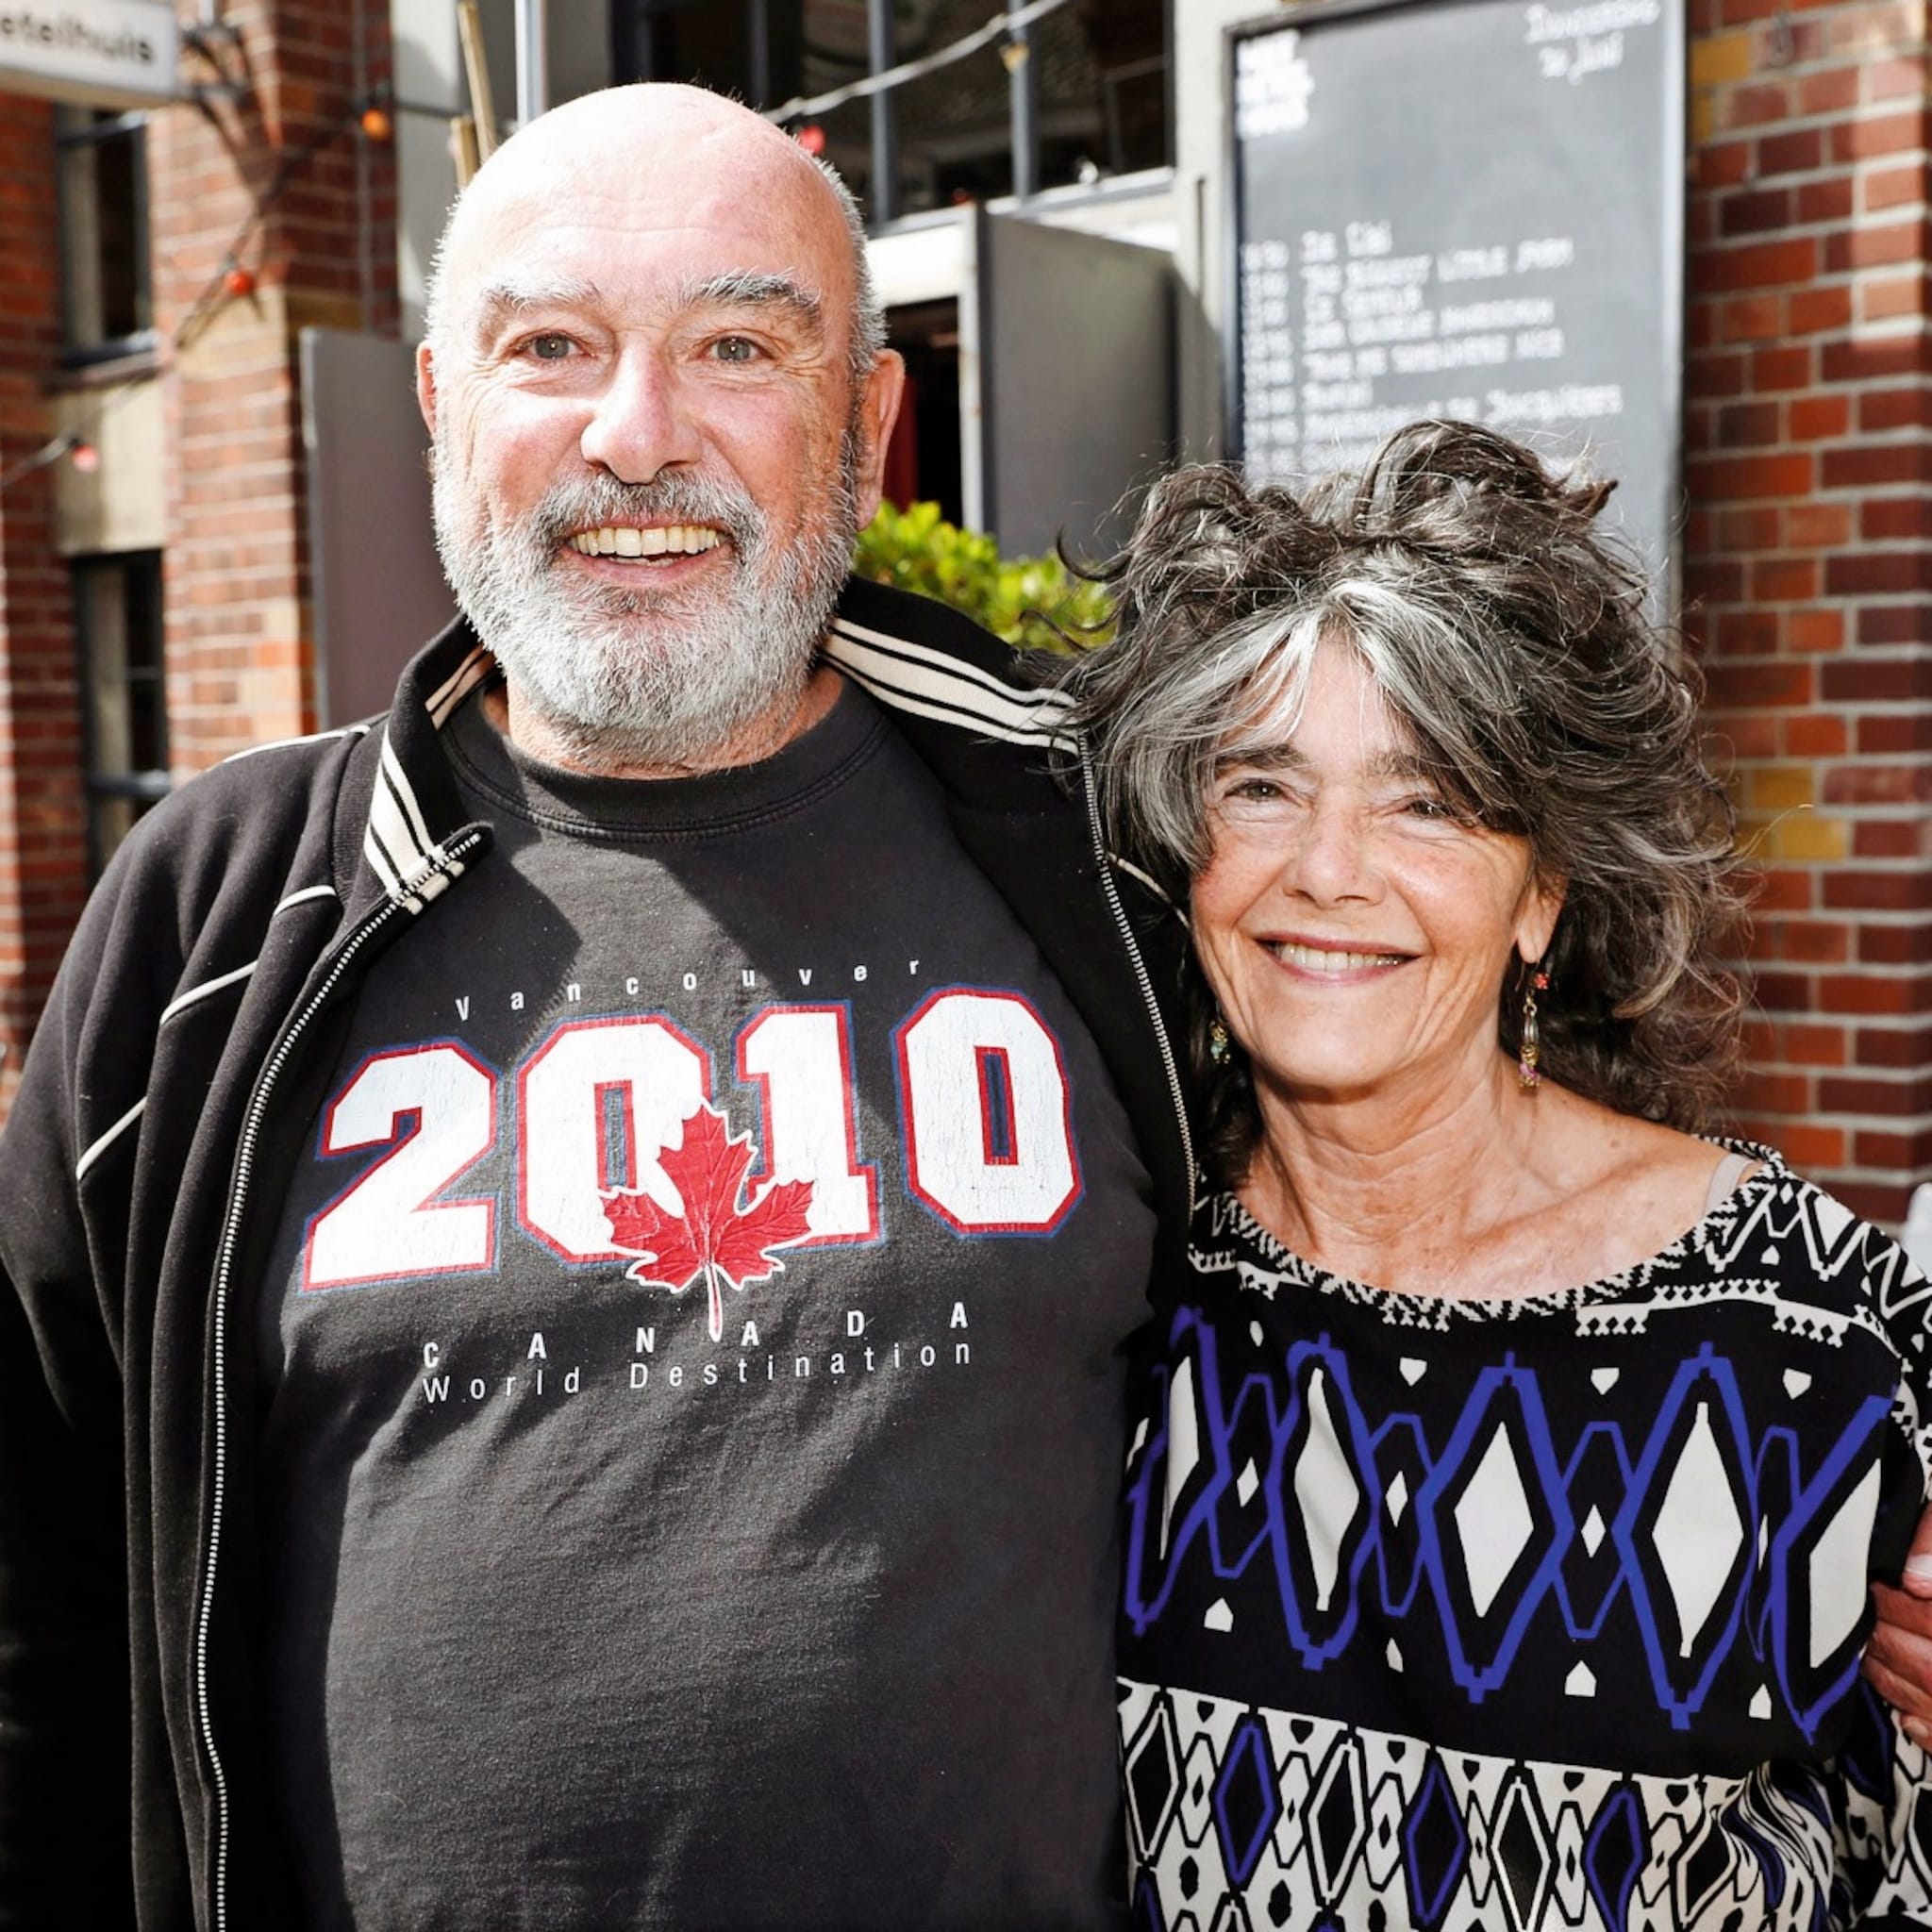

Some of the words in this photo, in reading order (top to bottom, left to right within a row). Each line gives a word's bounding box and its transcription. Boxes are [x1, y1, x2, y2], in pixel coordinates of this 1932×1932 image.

[455, 958, 921, 1022] Vancouver
[298, 983, 1085, 1295] 2010
[423, 1302, 968, 1369] CANADA
[423, 1365, 580, 1403] World
[630, 1341, 970, 1390] Destination
